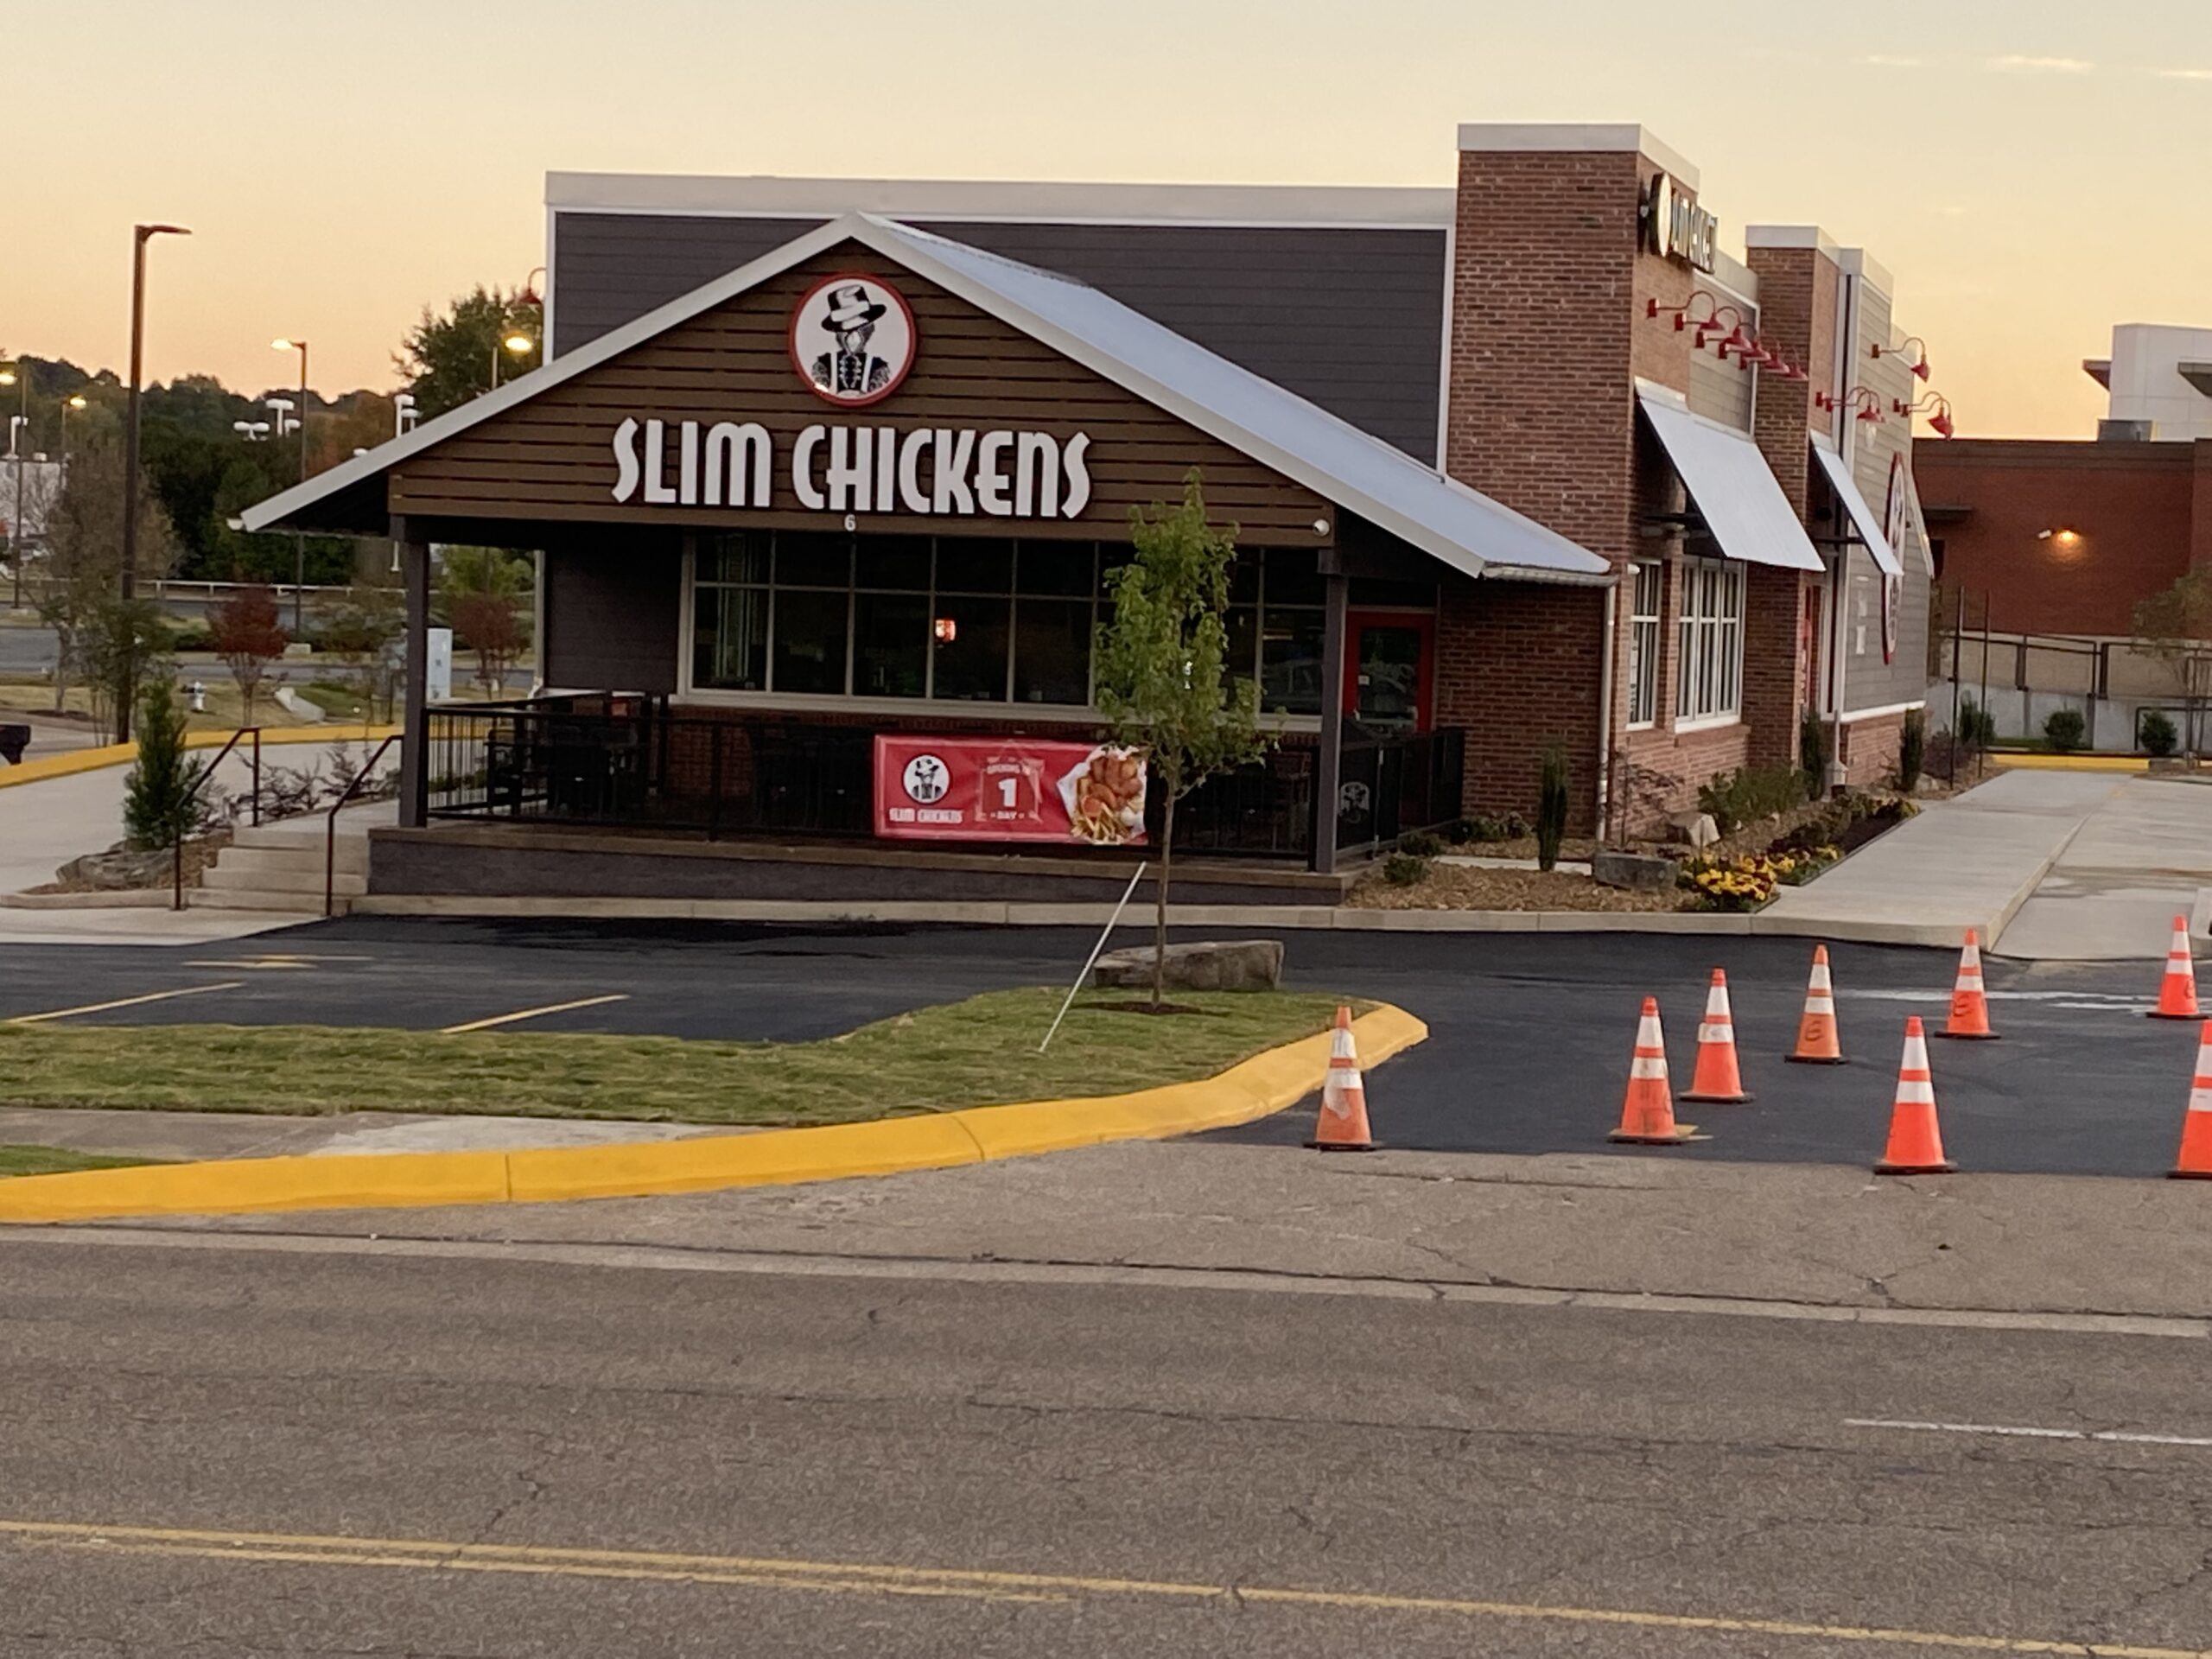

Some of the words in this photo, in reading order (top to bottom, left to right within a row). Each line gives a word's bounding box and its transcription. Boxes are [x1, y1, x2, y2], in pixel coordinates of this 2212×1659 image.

[611, 416, 772, 507] SLIM
[791, 423, 1090, 518] CHICKENS
[998, 778, 1017, 807] 1
